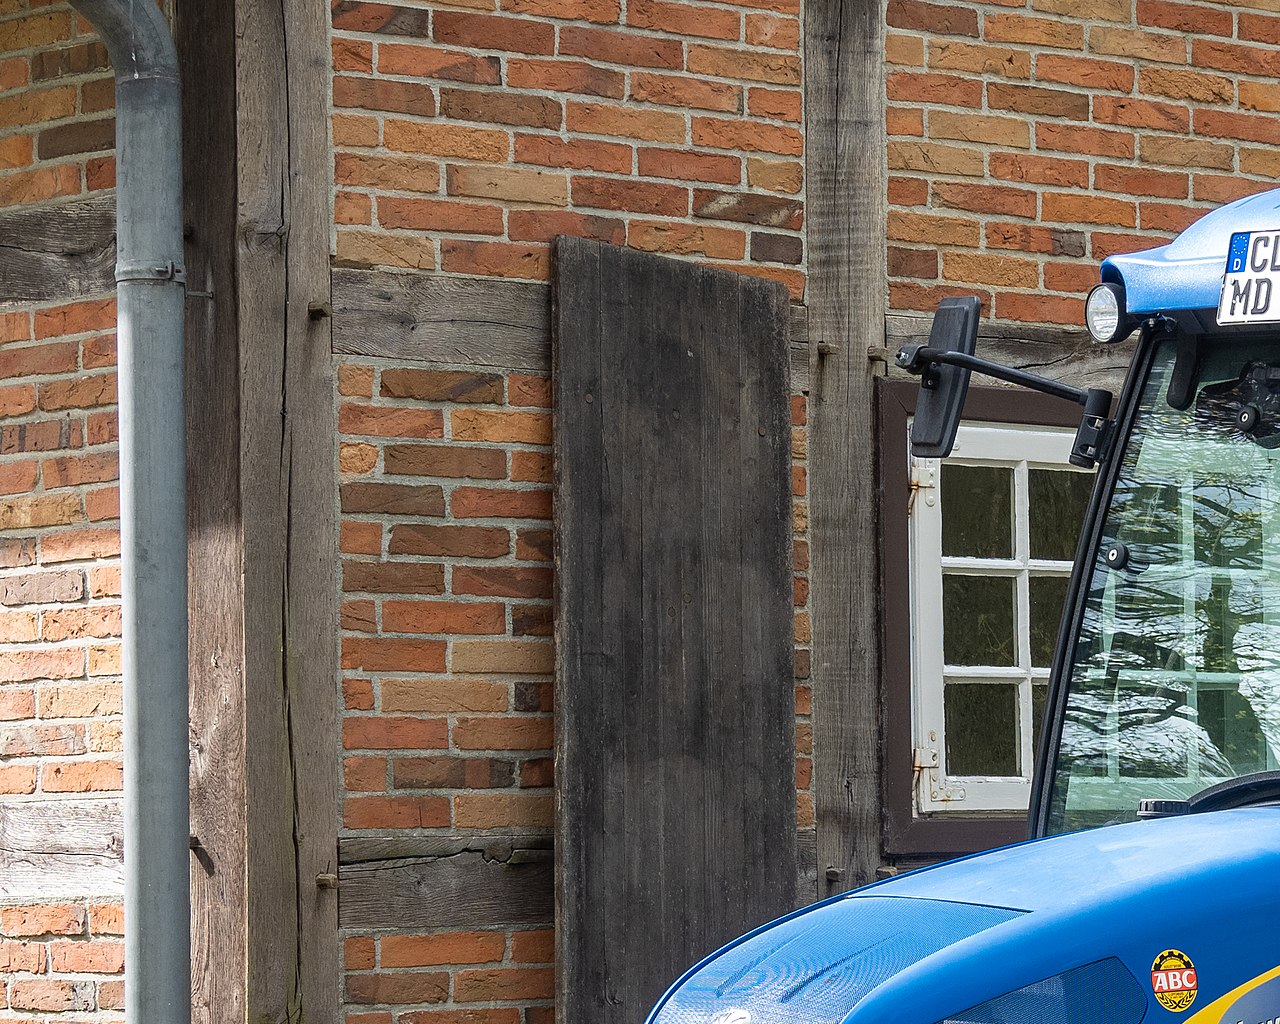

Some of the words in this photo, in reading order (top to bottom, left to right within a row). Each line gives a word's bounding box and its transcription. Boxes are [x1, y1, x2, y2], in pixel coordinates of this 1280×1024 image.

[1232, 257, 1242, 272] D
[1229, 277, 1273, 316] MD
[1153, 970, 1196, 991] ABC
